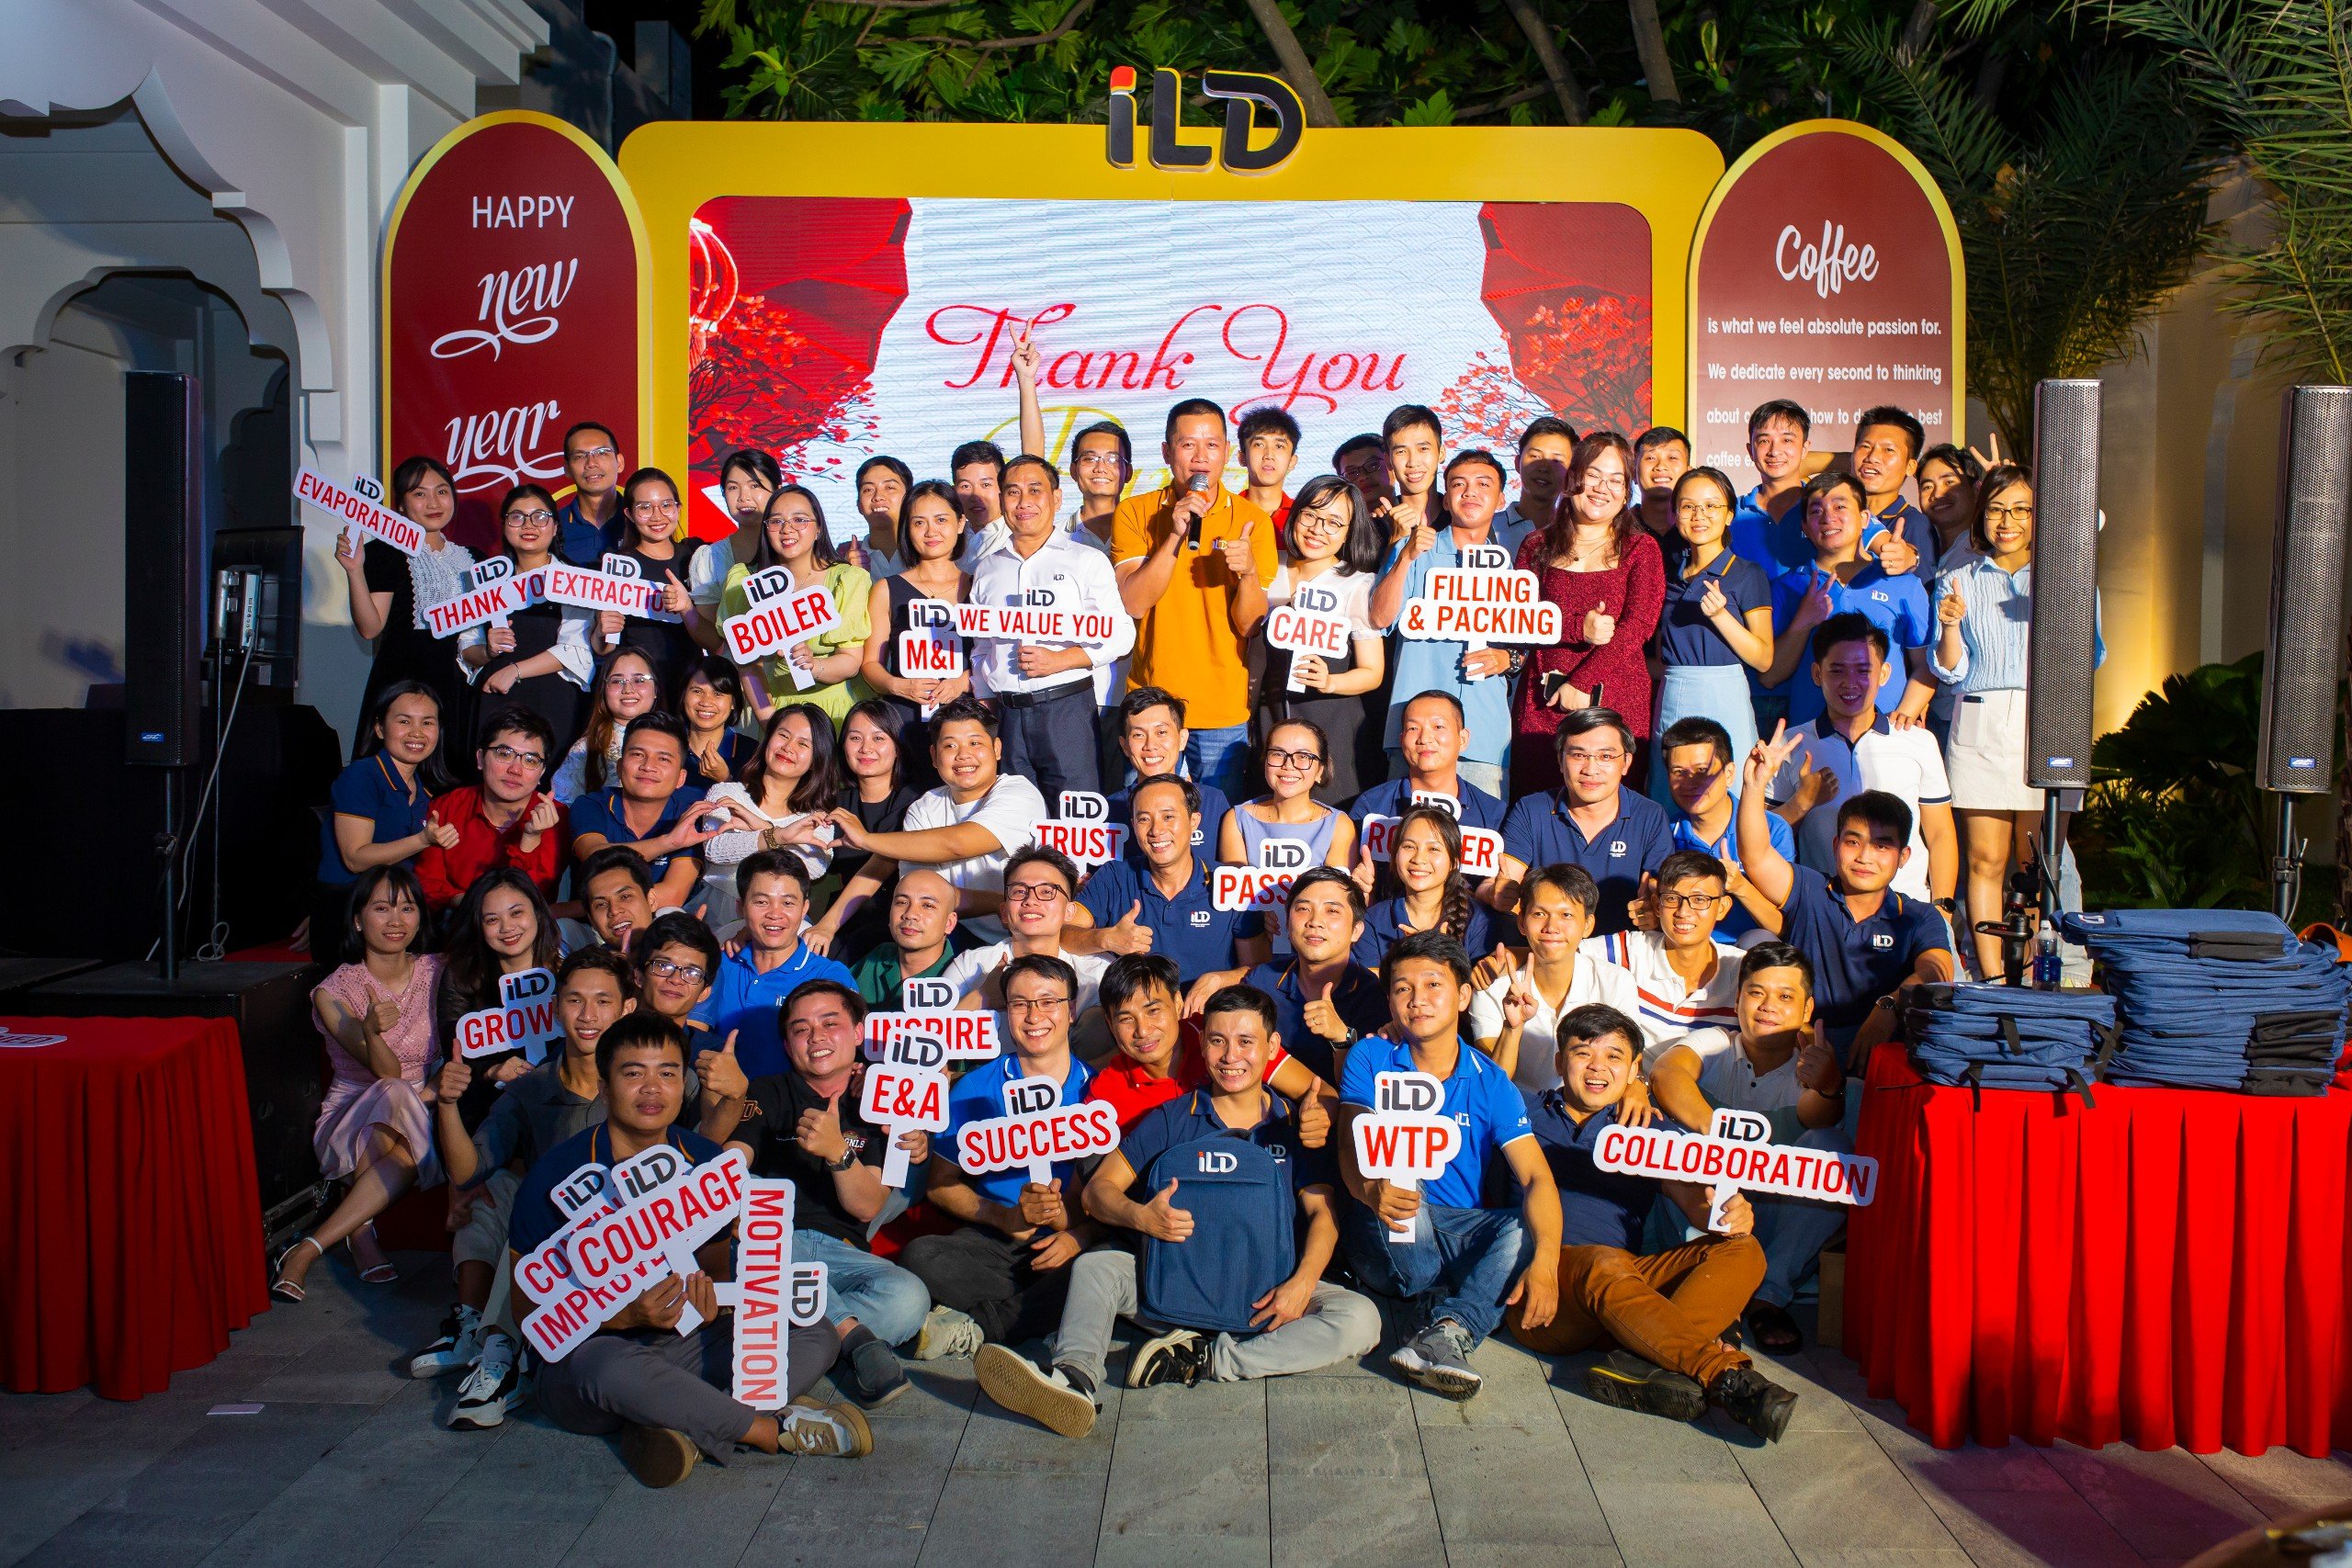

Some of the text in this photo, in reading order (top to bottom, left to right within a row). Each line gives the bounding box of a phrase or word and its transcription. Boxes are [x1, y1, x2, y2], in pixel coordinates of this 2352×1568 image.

[472, 196, 575, 228] HAPPY
[1775, 220, 1880, 299] Coffee
[430, 257, 579, 363] new
[1707, 318, 1942, 338] is what we feel absolute passion for.
[1222, 303, 1408, 425] You
[1707, 363, 1942, 385] We dedicate every second to thinking
[1706, 408, 1740, 424] about
[1810, 408, 1834, 424] how
[1837, 409, 1849, 424] to
[1917, 409, 1943, 424] best
[444, 400, 566, 493] year
[1706, 451, 1741, 468] coffee
[299, 474, 421, 551] EVAPORATION
[429, 570, 548, 632] THANK YO
[552, 570, 665, 613] EXTRACTIO
[1433, 575, 1531, 604] FILLING
[731, 592, 832, 655] BOILER
[959, 607, 1114, 639] WE VALUE YOU
[1273, 613, 1345, 652] CARE
[1408, 604, 1555, 636] & PACKING
[906, 638, 956, 671] M&I
[1036, 824, 1122, 859] TRUST
[1219, 874, 1302, 905] PASS
[872, 1074, 941, 1122] E&A
[965, 1110, 1113, 1168] SUCCESS
[1363, 1125, 1449, 1168] WTP
[1602, 1132, 1871, 1199] COLLOBORATION
[577, 1157, 741, 1279] COURAGE
[741, 1190, 786, 1402] MOTIVATION
